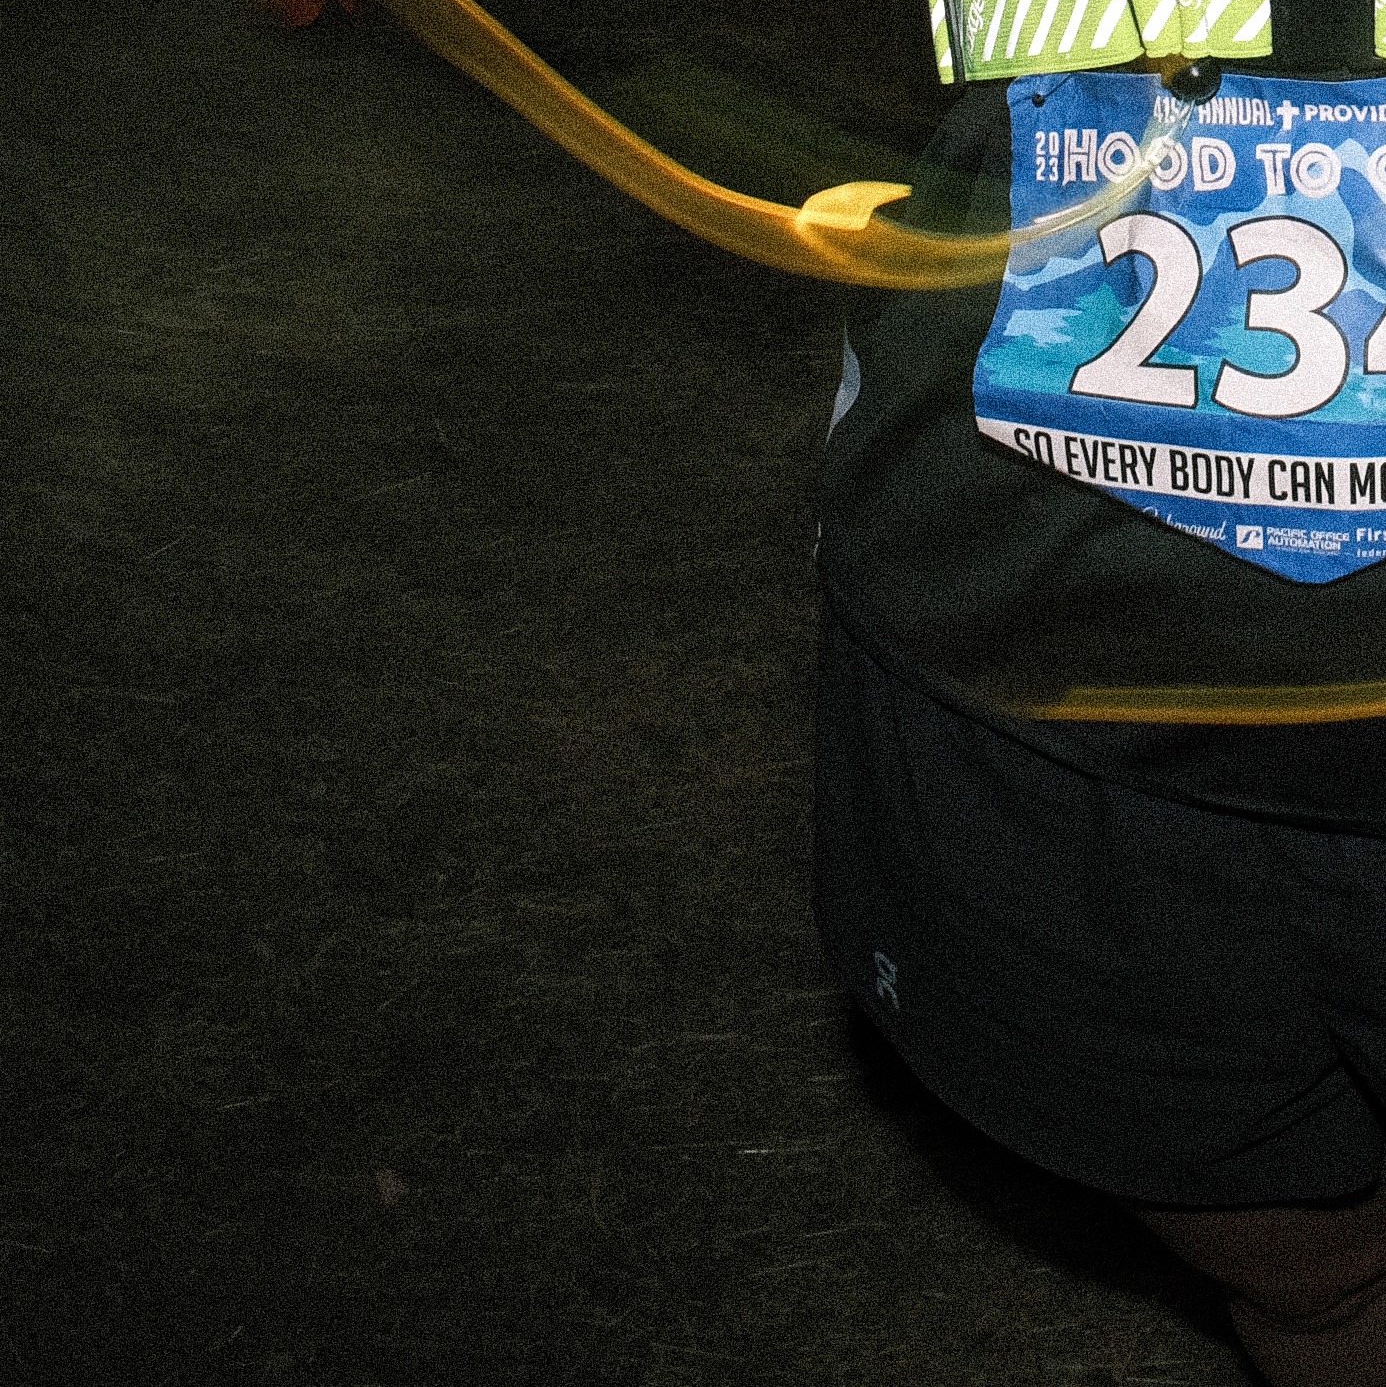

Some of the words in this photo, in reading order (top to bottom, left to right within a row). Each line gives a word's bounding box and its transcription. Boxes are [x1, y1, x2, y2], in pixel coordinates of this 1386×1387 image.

[1198, 96, 1275, 126] ANNUAL
[1063, 128, 1236, 192] HOOD
[1255, 141, 1342, 199] TO
[1013, 428, 1055, 470] SO
[1063, 435, 1157, 487] EVERY
[1169, 448, 1255, 500] BODY
[1268, 458, 1335, 505] CAN
[1268, 536, 1341, 551] AUTOMATION
